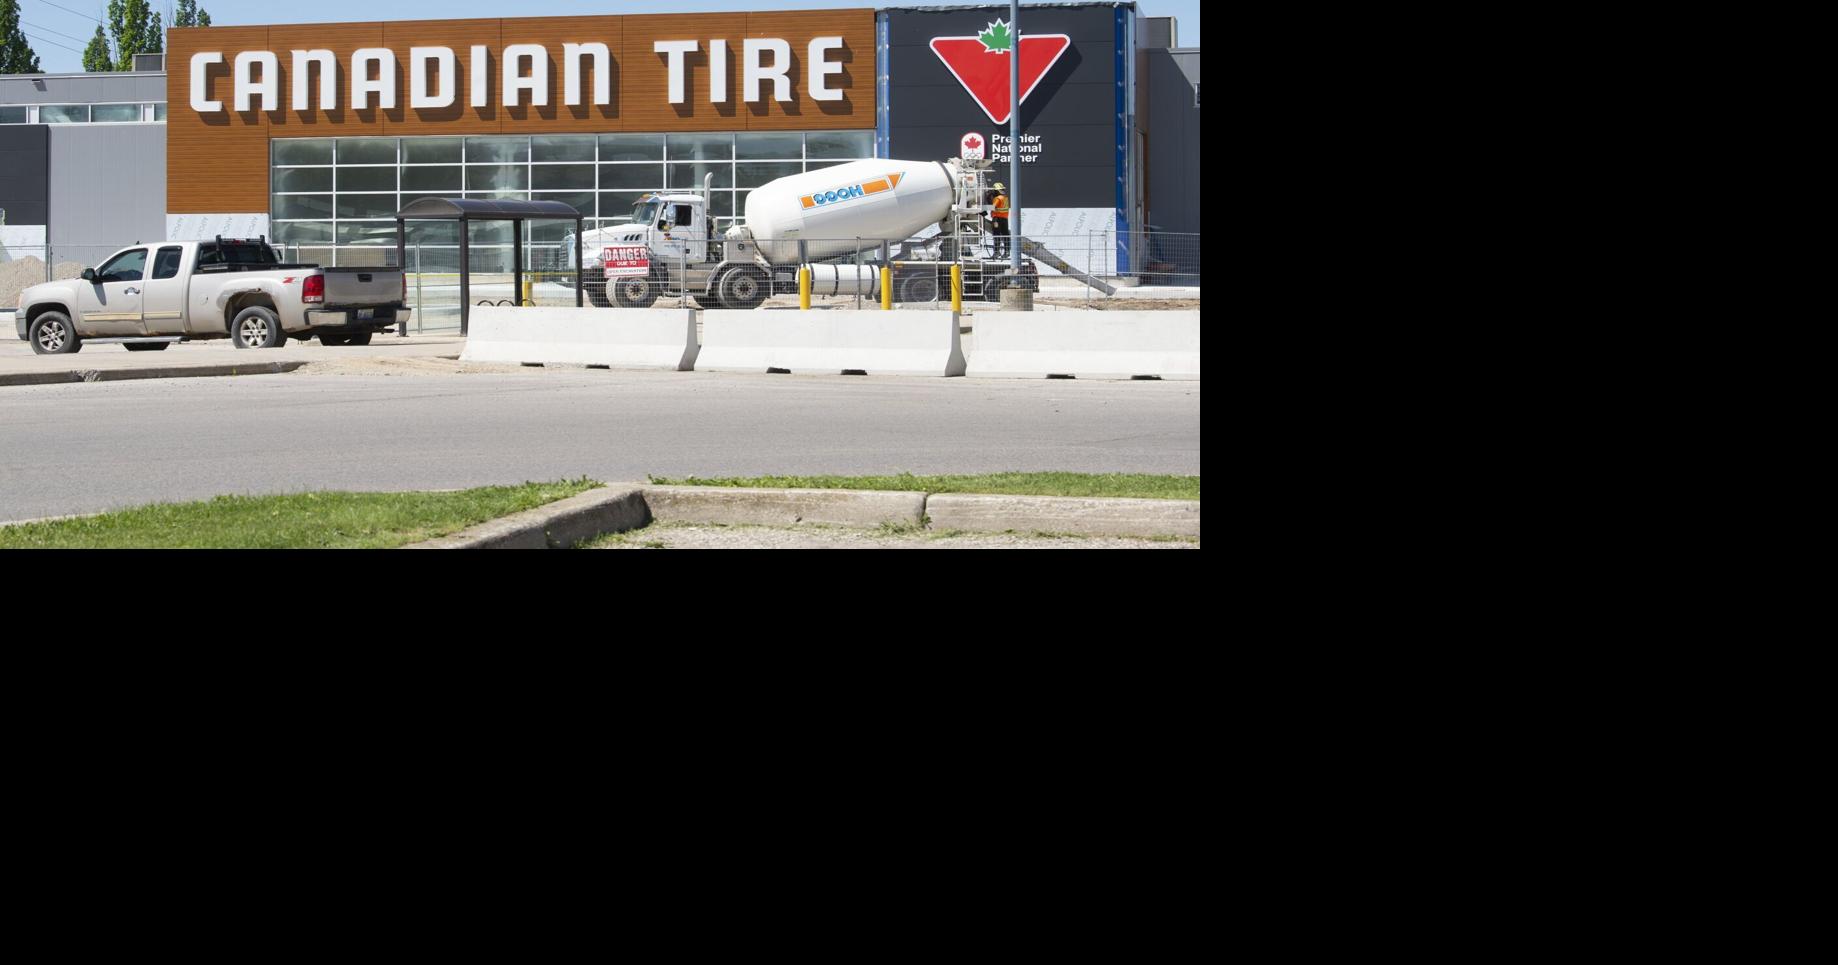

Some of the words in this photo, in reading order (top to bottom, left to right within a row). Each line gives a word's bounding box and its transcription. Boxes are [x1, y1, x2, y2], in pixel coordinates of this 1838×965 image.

[191, 43, 609, 111] CANADIAN
[655, 37, 842, 103] TIRE
[992, 143, 1042, 153] Natonal
[992, 153, 1038, 163] Parner
[604, 247, 647, 261] DANGER
